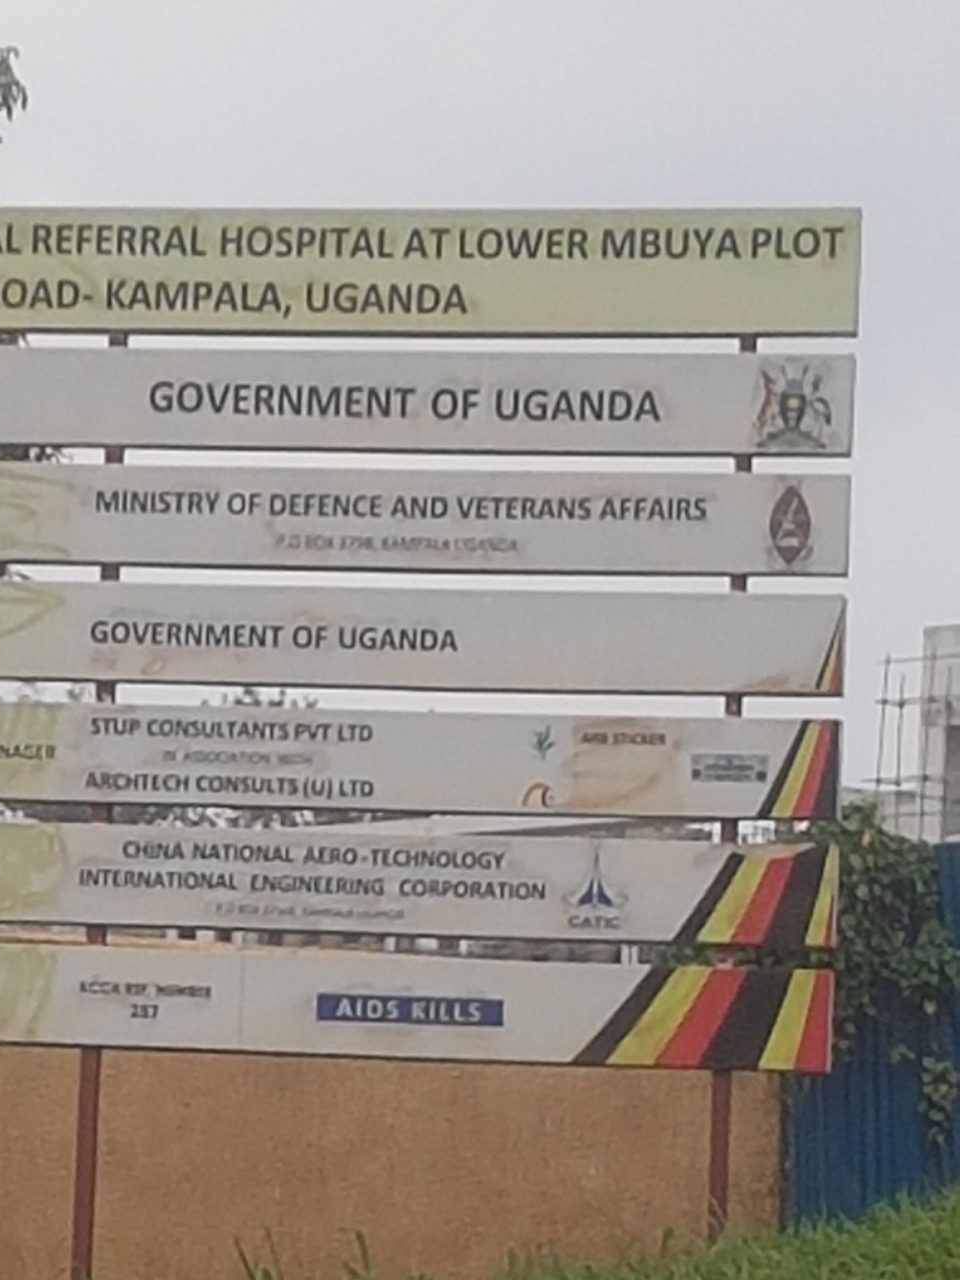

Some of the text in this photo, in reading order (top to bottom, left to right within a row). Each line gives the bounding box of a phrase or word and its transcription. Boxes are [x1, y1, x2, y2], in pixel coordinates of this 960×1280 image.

[32, 223, 205, 256] REFERRAL
[220, 226, 393, 258] HOSPITAL
[403, 227, 450, 258] AT
[460, 227, 588, 259] LOWER
[601, 226, 740, 259] MBUYA
[751, 226, 844, 259] PLOT
[106, 280, 292, 318] KAMPALA,
[305, 283, 468, 315] UGANDA
[149, 381, 661, 423] GOVERNMENT OF UGANDA
[95, 491, 707, 521] MINISTRY OF DEFENCE AND VETERANS AFFAIRS
[90, 620, 458, 652] GOVERNMENT OF UGANDA
[147, 719, 289, 742] CONSULTANTS
[294, 723, 332, 743] PVT
[338, 724, 373, 743] LTD
[196, 774, 298, 796] CONSULTS
[340, 778, 374, 797] LTD
[122, 840, 185, 861] CHINA
[191, 842, 294, 863] NATIONAL
[79, 869, 546, 900] INTERNATIONAL ENGINEERING CORPORATION
[568, 914, 621, 930] CATIC
[335, 998, 482, 1023] AIDS KILLS
